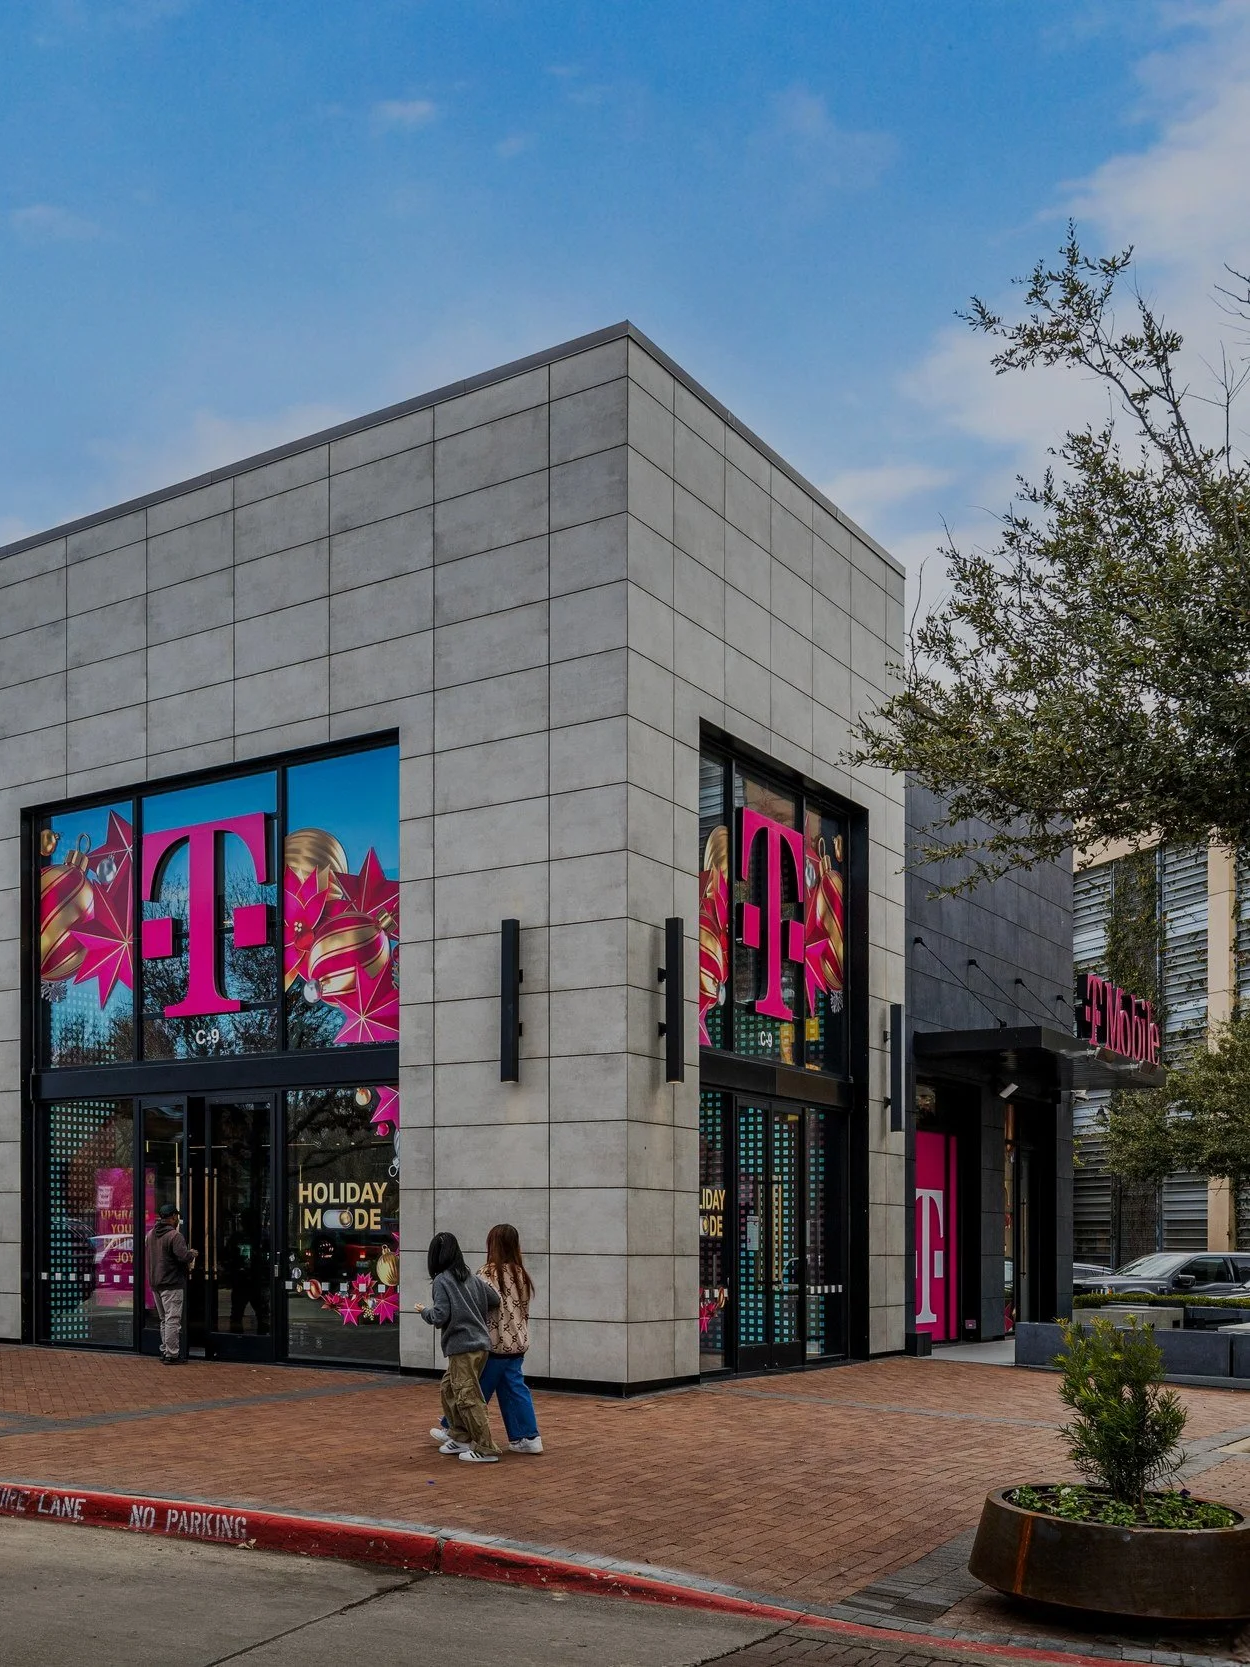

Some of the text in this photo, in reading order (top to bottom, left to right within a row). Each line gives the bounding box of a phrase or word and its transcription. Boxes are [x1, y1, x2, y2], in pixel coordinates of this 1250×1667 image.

[142, 811, 266, 1018] T
[741, 806, 804, 1022] T
[195, 1029, 220, 1046] C-9
[298, 1182, 388, 1204] HOLIDAY
[699, 1188, 726, 1211] IDAY
[111, 1223, 134, 1234] YOU
[915, 1188, 944, 1325] T
[36, 1494, 87, 1522] LANE
[130, 1504, 247, 1540] NO PARKING
